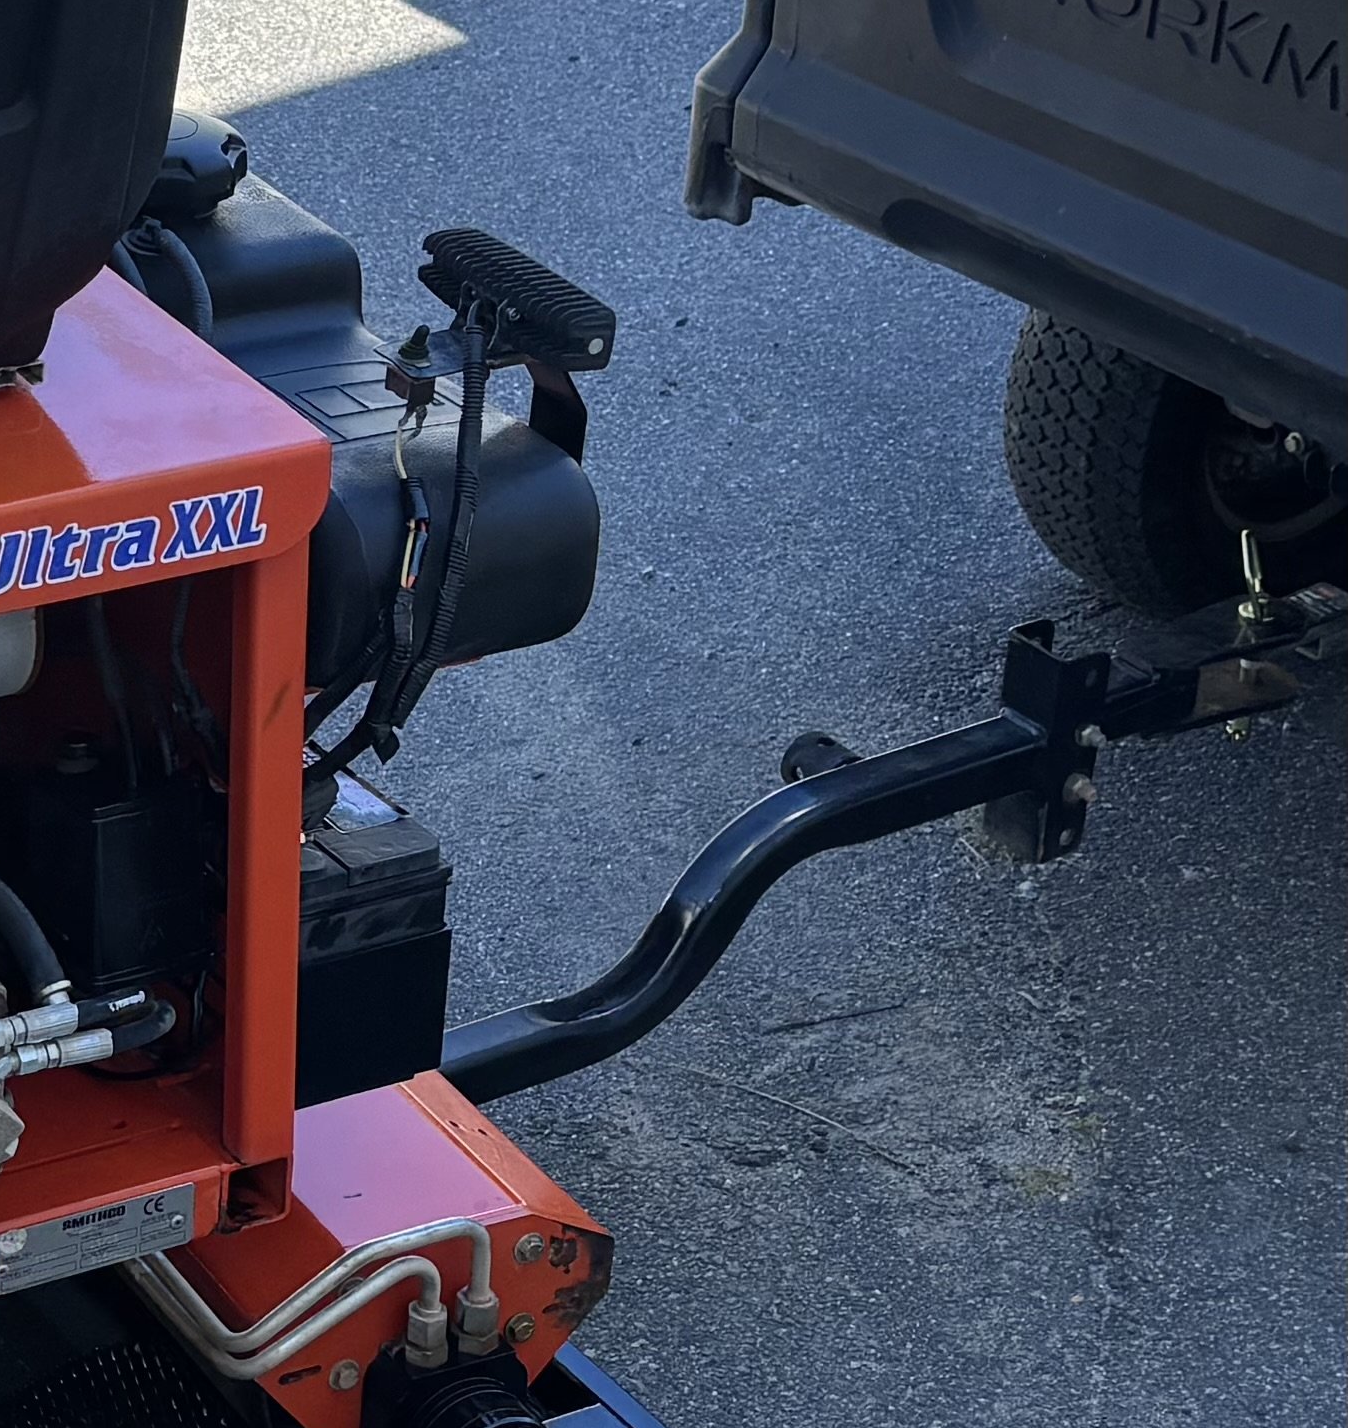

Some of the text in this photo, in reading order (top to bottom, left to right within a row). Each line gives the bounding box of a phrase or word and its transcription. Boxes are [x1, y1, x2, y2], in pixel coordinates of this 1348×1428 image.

[162, 484, 268, 562] XXL
[62, 1205, 127, 1231] SMITHCO
[143, 1195, 165, 1215] CE
